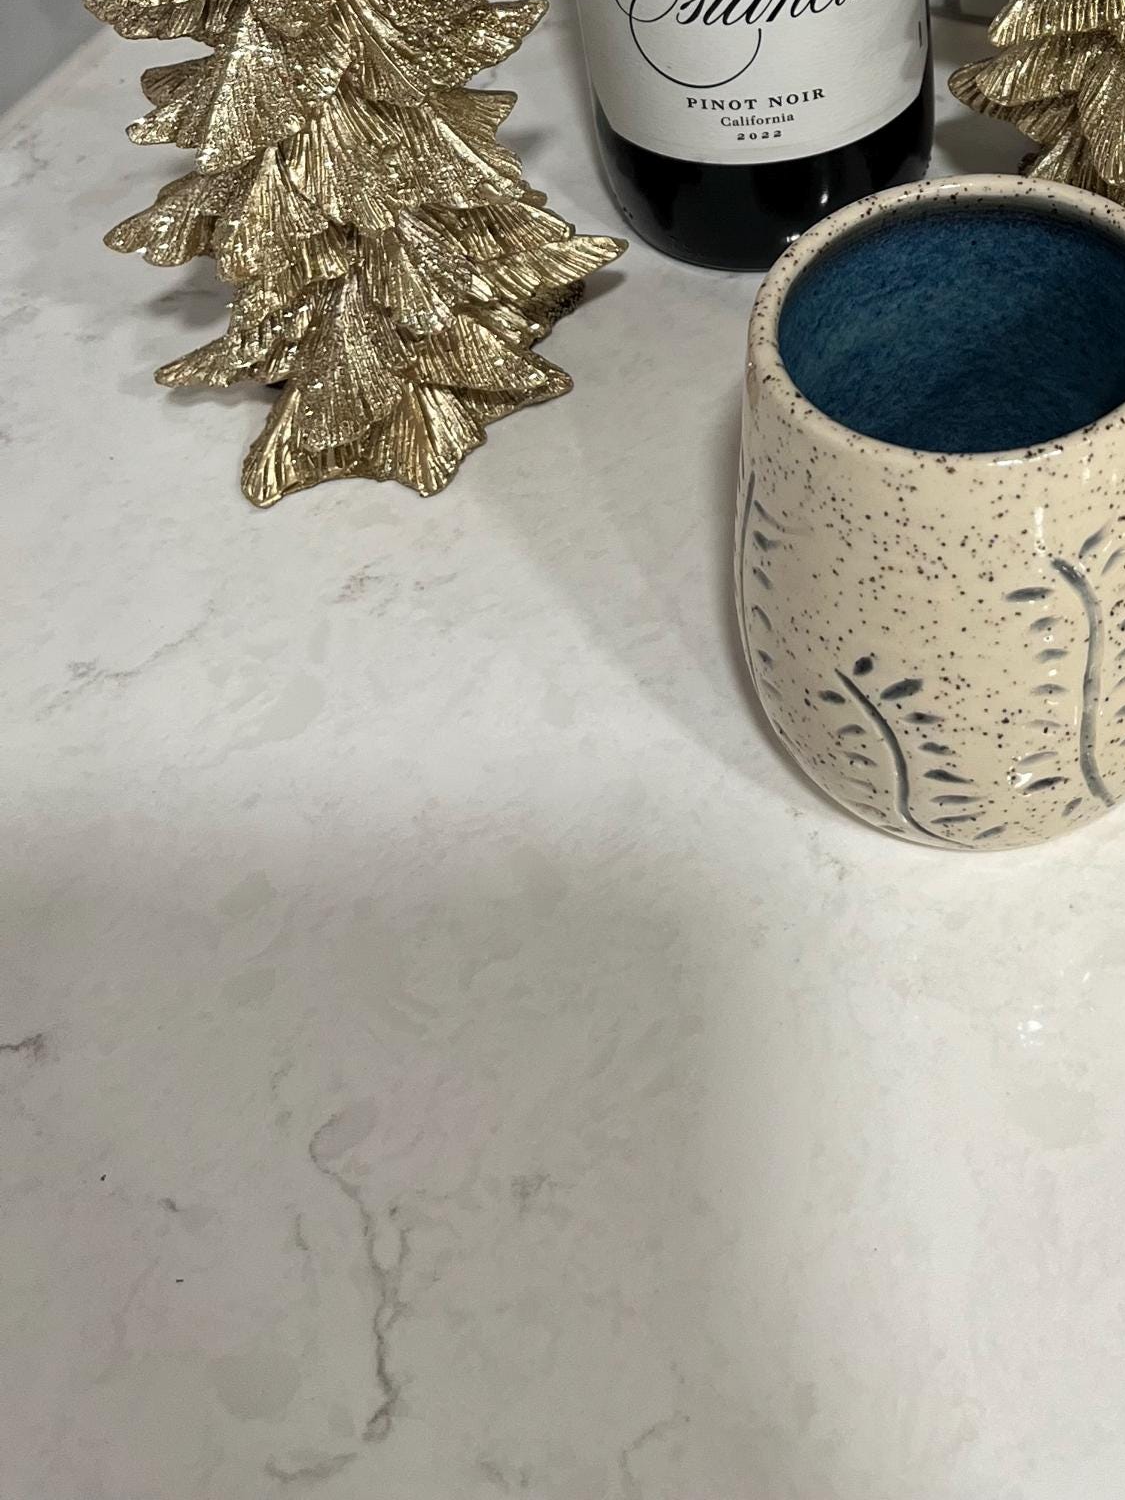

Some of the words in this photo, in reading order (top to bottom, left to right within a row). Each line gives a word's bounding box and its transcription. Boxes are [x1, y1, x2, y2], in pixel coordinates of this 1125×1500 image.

[686, 97, 758, 111] PINOT
[767, 88, 826, 109] NOIR
[720, 113, 795, 127] California
[736, 130, 783, 141] 2022
